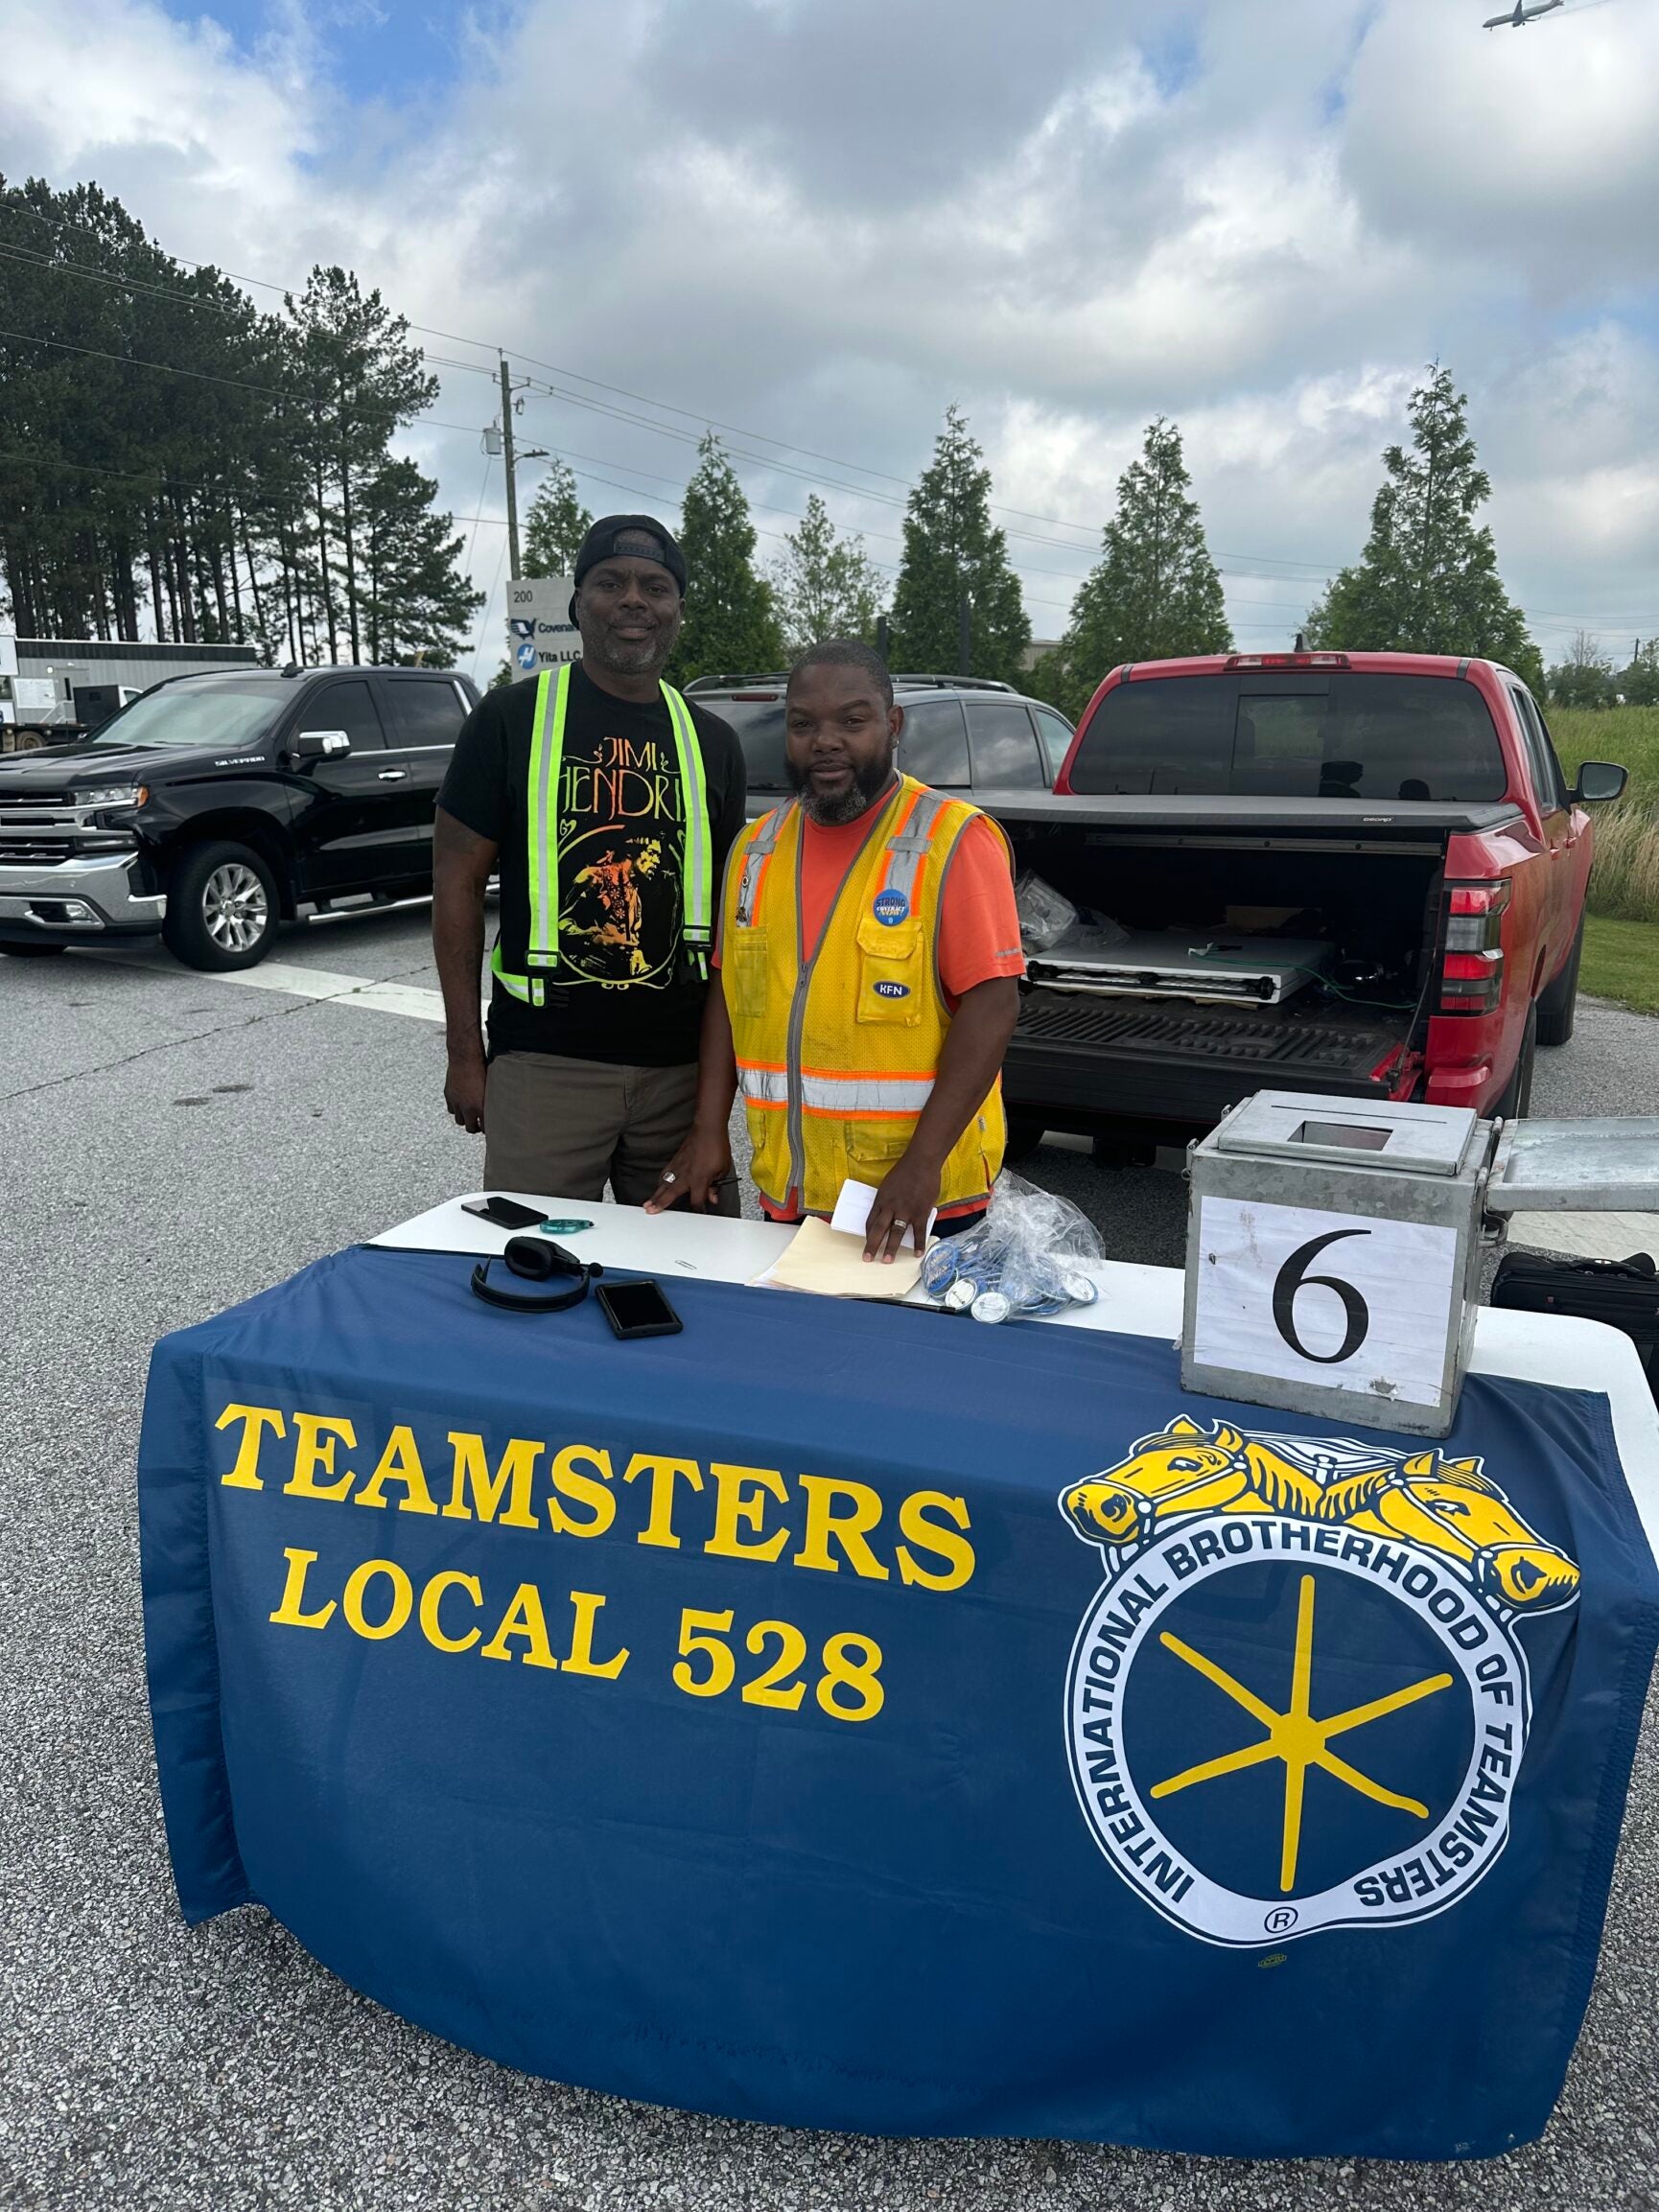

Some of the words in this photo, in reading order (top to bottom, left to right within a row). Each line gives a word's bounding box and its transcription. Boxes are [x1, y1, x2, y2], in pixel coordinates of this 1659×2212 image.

[514, 591, 533, 602] 200
[560, 650, 581, 662] LLC
[603, 736, 657, 771] JIMI
[559, 766, 686, 822] HENDRI
[876, 896, 906, 907] STRONG
[879, 984, 902, 995] KFN
[1273, 1229, 1371, 1363] 6
[214, 1403, 976, 1592] TEAMSTERS
[1161, 1520, 1488, 1651] BROTHERHOOD
[269, 1547, 630, 1680] LOCAL
[672, 1608, 885, 1722] 528
[1474, 1657, 1514, 1707] OF
[1082, 1574, 1196, 1903] INTERNATIONAL
[1354, 1722, 1513, 1907] TEAMSTERS
